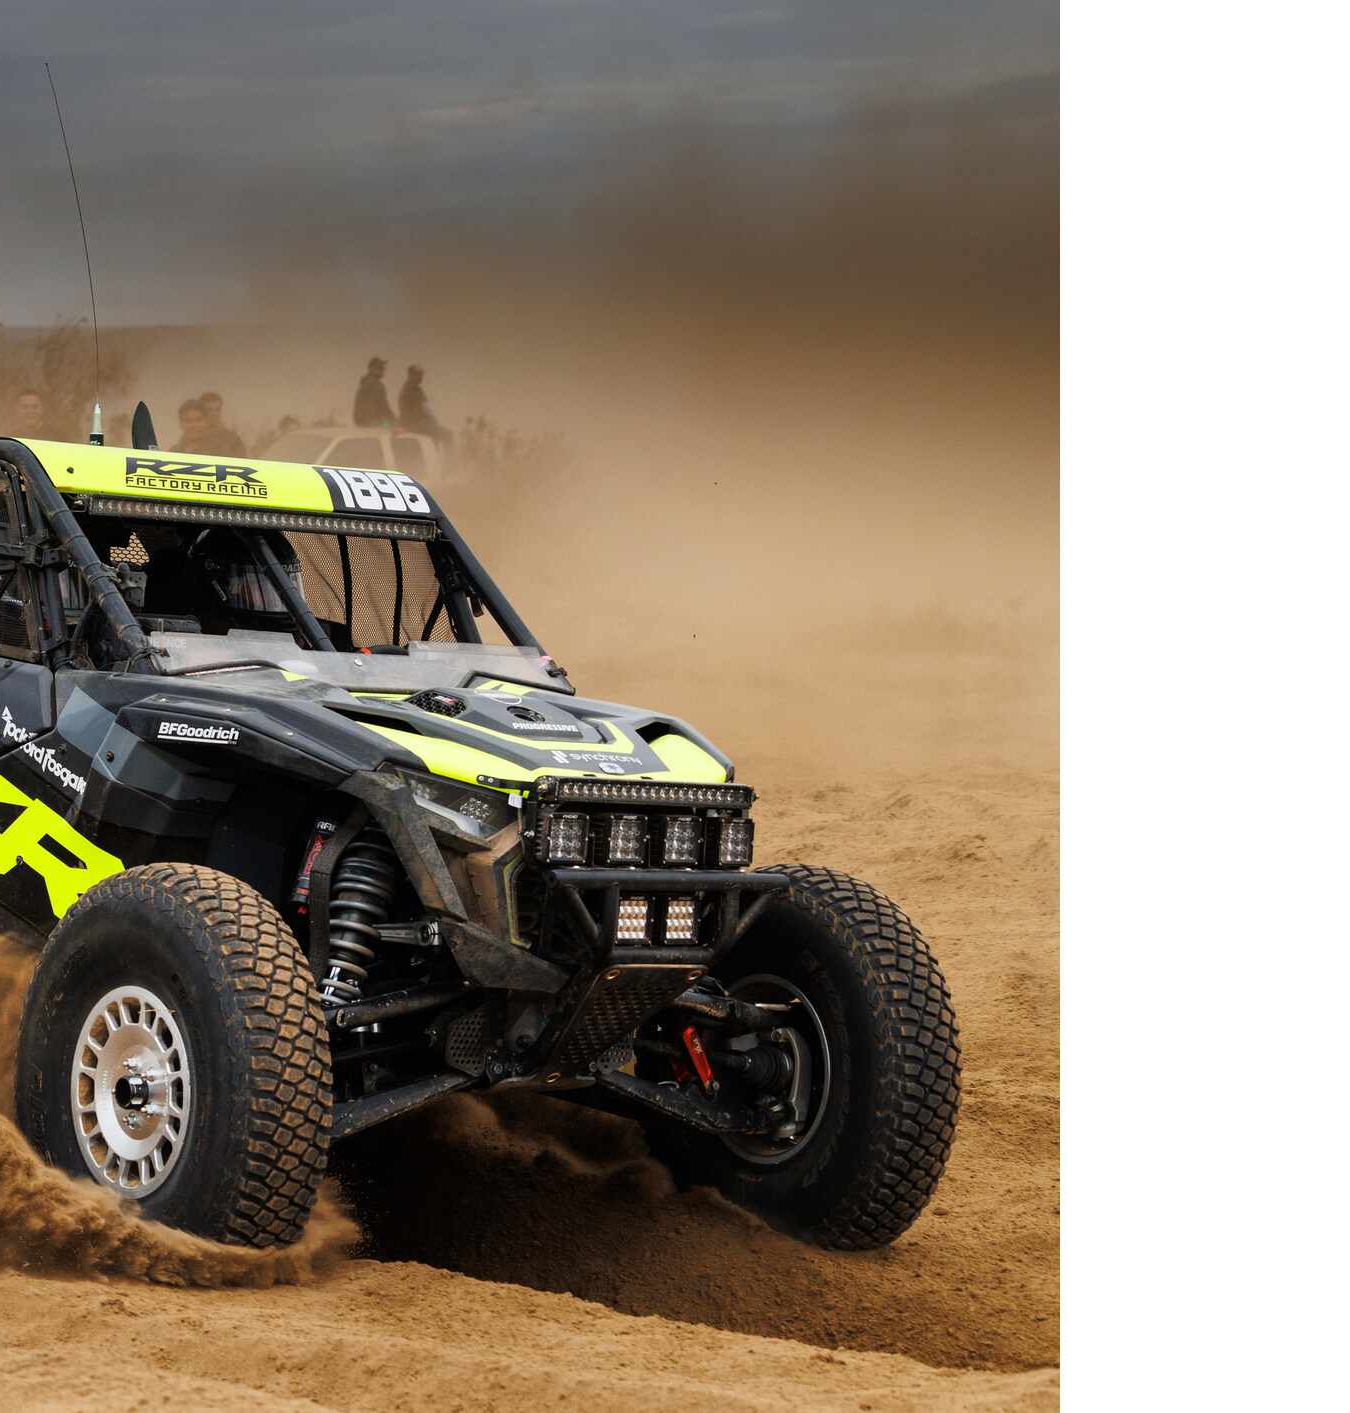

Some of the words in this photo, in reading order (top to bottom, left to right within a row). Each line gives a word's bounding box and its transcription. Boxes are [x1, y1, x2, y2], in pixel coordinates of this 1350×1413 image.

[125, 456, 264, 484] RZR
[125, 476, 201, 491] FACTORY
[207, 482, 268, 496] RACING
[323, 468, 431, 514] 1896
[158, 721, 240, 740] BFGoodrich
[512, 722, 579, 732] PROGRESSIVE
[569, 752, 643, 766] synchrony
